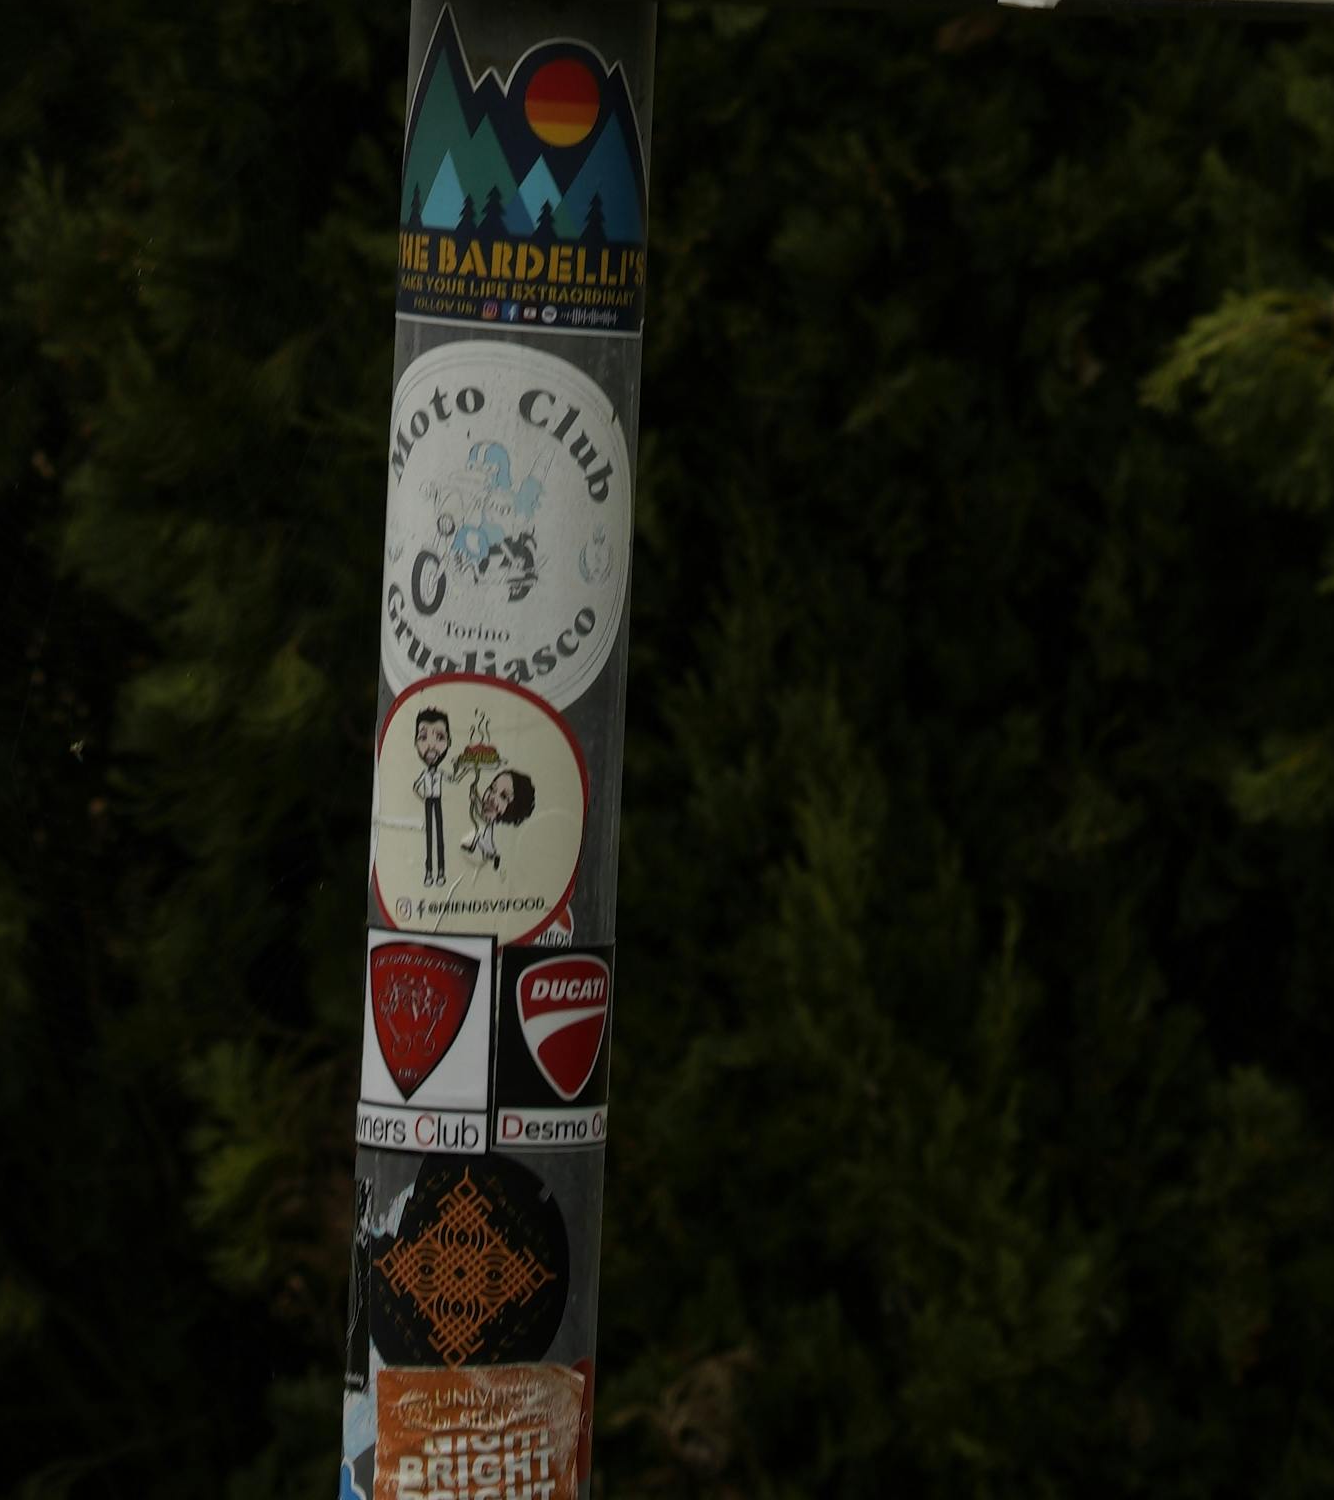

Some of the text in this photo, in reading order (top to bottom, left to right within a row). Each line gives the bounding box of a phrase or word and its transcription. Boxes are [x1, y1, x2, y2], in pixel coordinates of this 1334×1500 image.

[437, 237, 646, 285] BARDELLI'S
[413, 297, 452, 311] FOLLOW
[425, 276, 635, 306] YOUR LIFE EXTRAORDINARY
[391, 386, 614, 503] Moto Club
[443, 619, 511, 644] Torino
[530, 977, 605, 1002] DUCATI
[414, 1114, 480, 1149] Club
[501, 1115, 587, 1140] Desmo
[398, 1448, 555, 1487] BRIGHT
